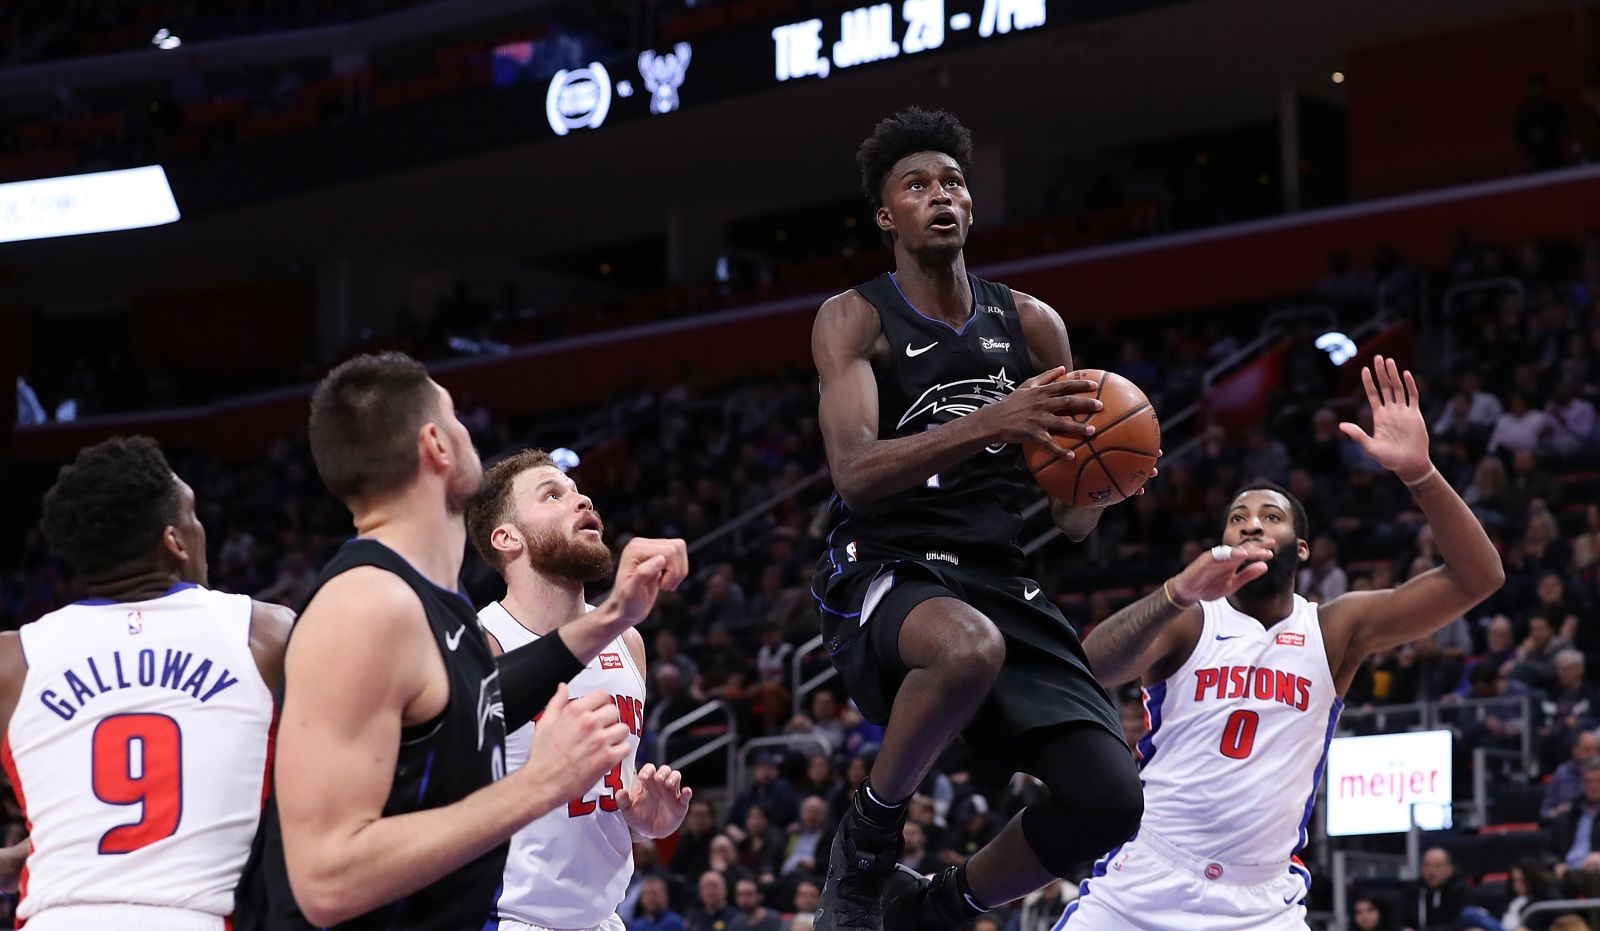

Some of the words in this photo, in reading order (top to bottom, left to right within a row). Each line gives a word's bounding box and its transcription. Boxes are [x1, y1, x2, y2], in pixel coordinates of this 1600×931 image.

[40, 649, 239, 721] GALLOWAY
[1194, 666, 1312, 712] PISTONS
[1220, 709, 1259, 760] 0
[92, 712, 182, 855] 9
[1340, 761, 1438, 804] meijer
